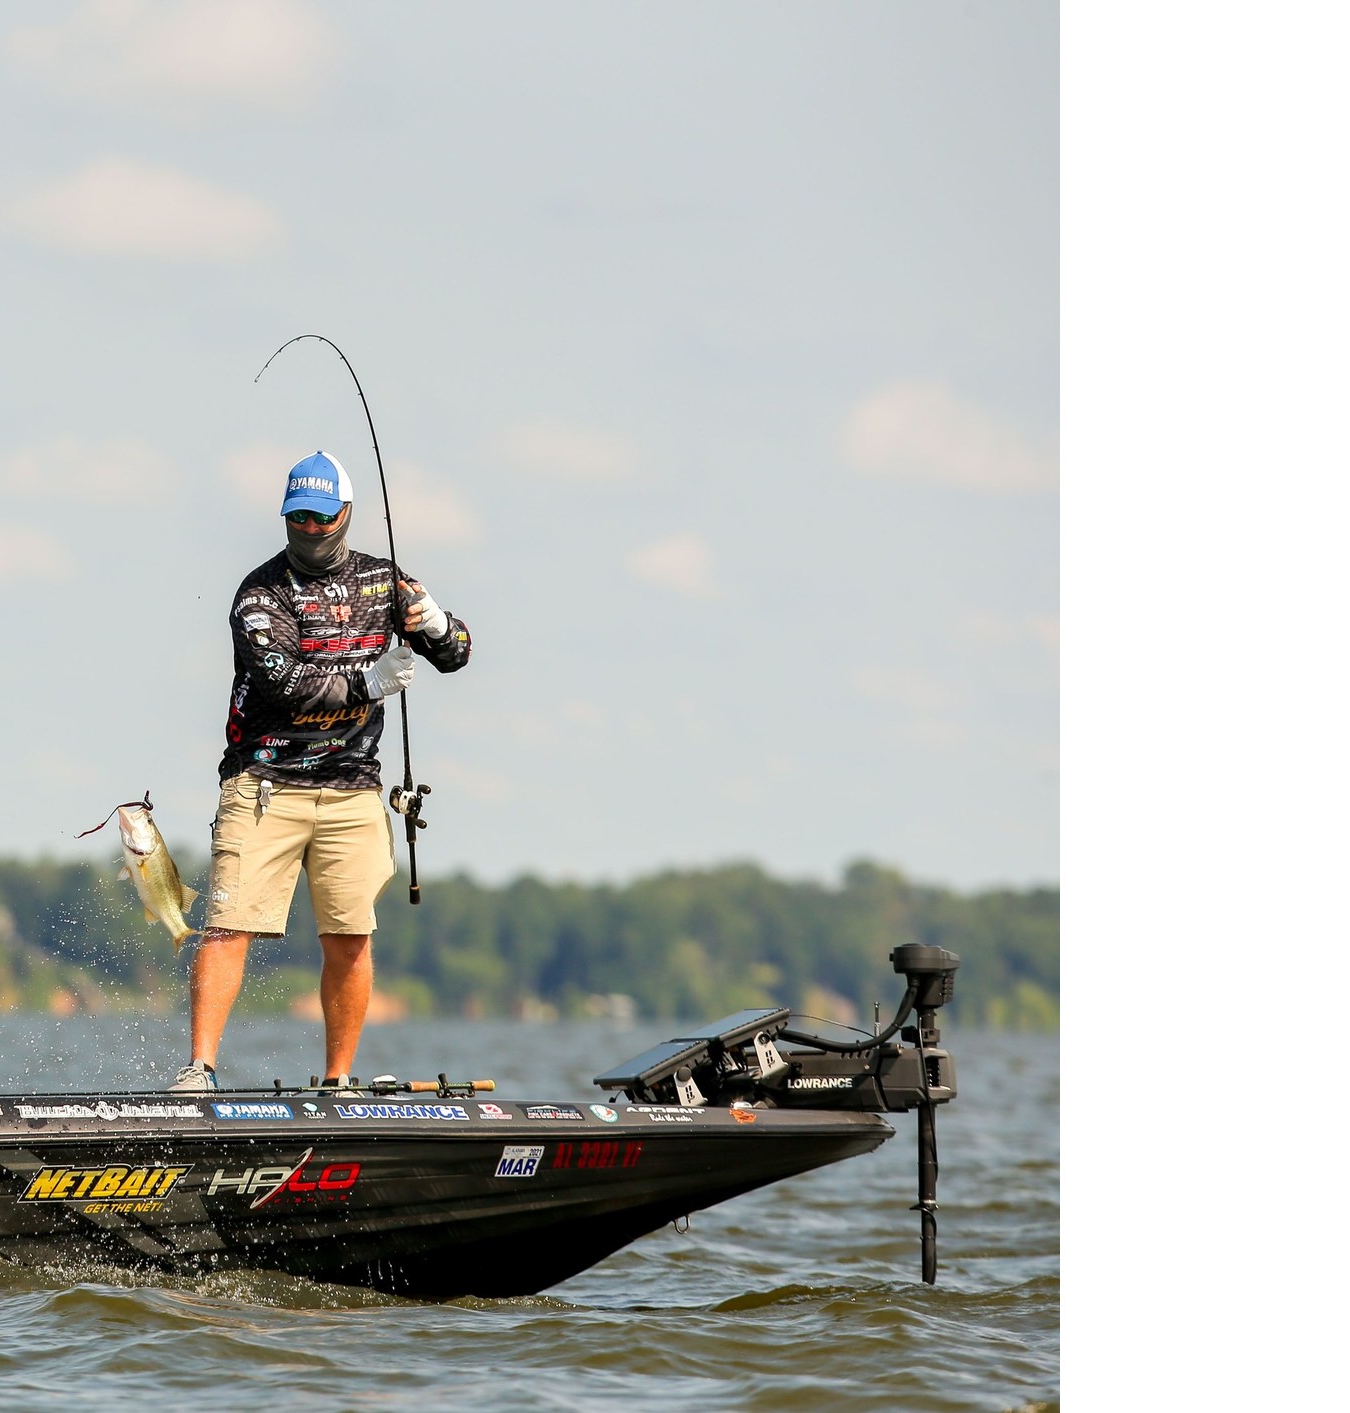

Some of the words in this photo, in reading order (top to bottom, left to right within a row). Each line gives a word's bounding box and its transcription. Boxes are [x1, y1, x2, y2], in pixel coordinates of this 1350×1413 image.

[297, 476, 334, 495] YAMAHA
[787, 1077, 853, 1089] LOWRANCE
[232, 1104, 289, 1115] YAMAHA
[334, 1105, 470, 1120] LOWRANCE
[497, 1158, 537, 1175] MAR
[25, 1167, 188, 1199] NETBAIT
[207, 1156, 362, 1203] HALO
[83, 1202, 109, 1214] GET
[108, 1202, 133, 1213] THE
